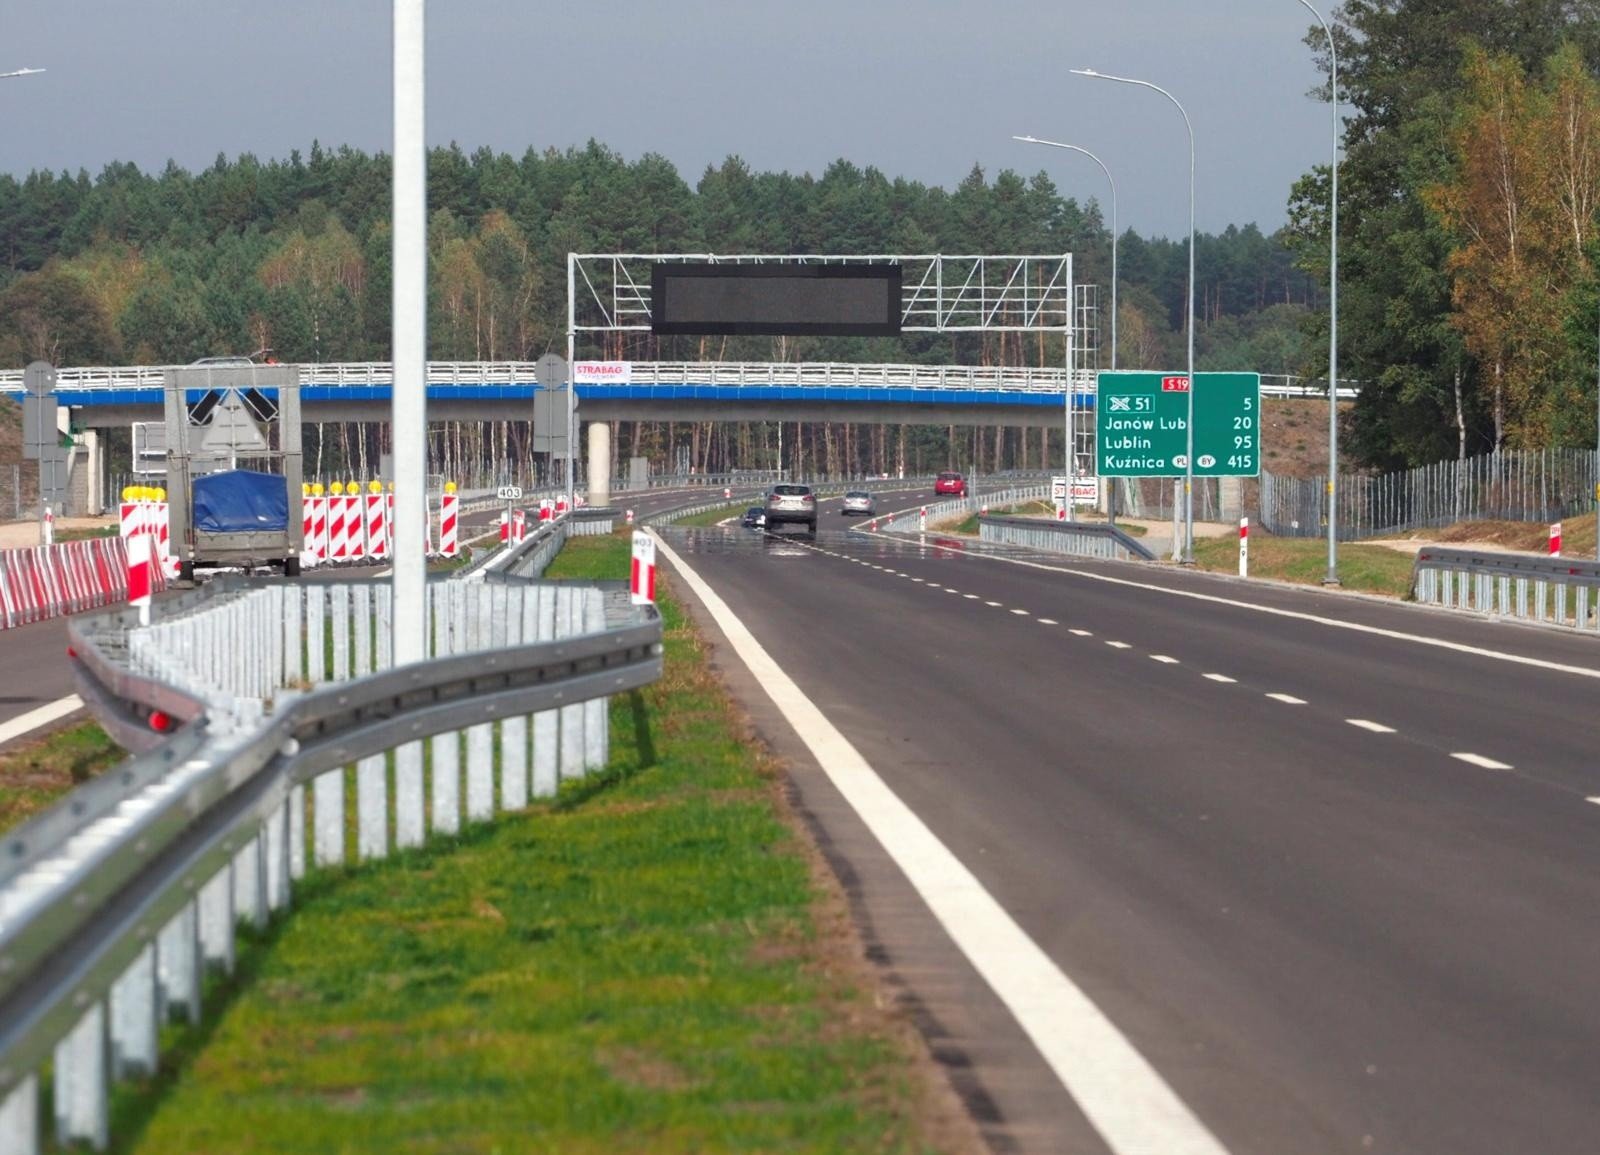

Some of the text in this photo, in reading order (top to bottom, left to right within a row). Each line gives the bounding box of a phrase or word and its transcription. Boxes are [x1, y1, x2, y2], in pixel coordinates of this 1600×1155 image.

[576, 365, 623, 374] STRABAG
[1135, 398, 1252, 411] 51 5
[1105, 416, 1154, 430] Janów
[1233, 417, 1252, 430] 20
[1105, 436, 1252, 449] Lublin 95
[1105, 455, 1252, 469] Kuźnica PL BY 415
[499, 488, 520, 498] 403
